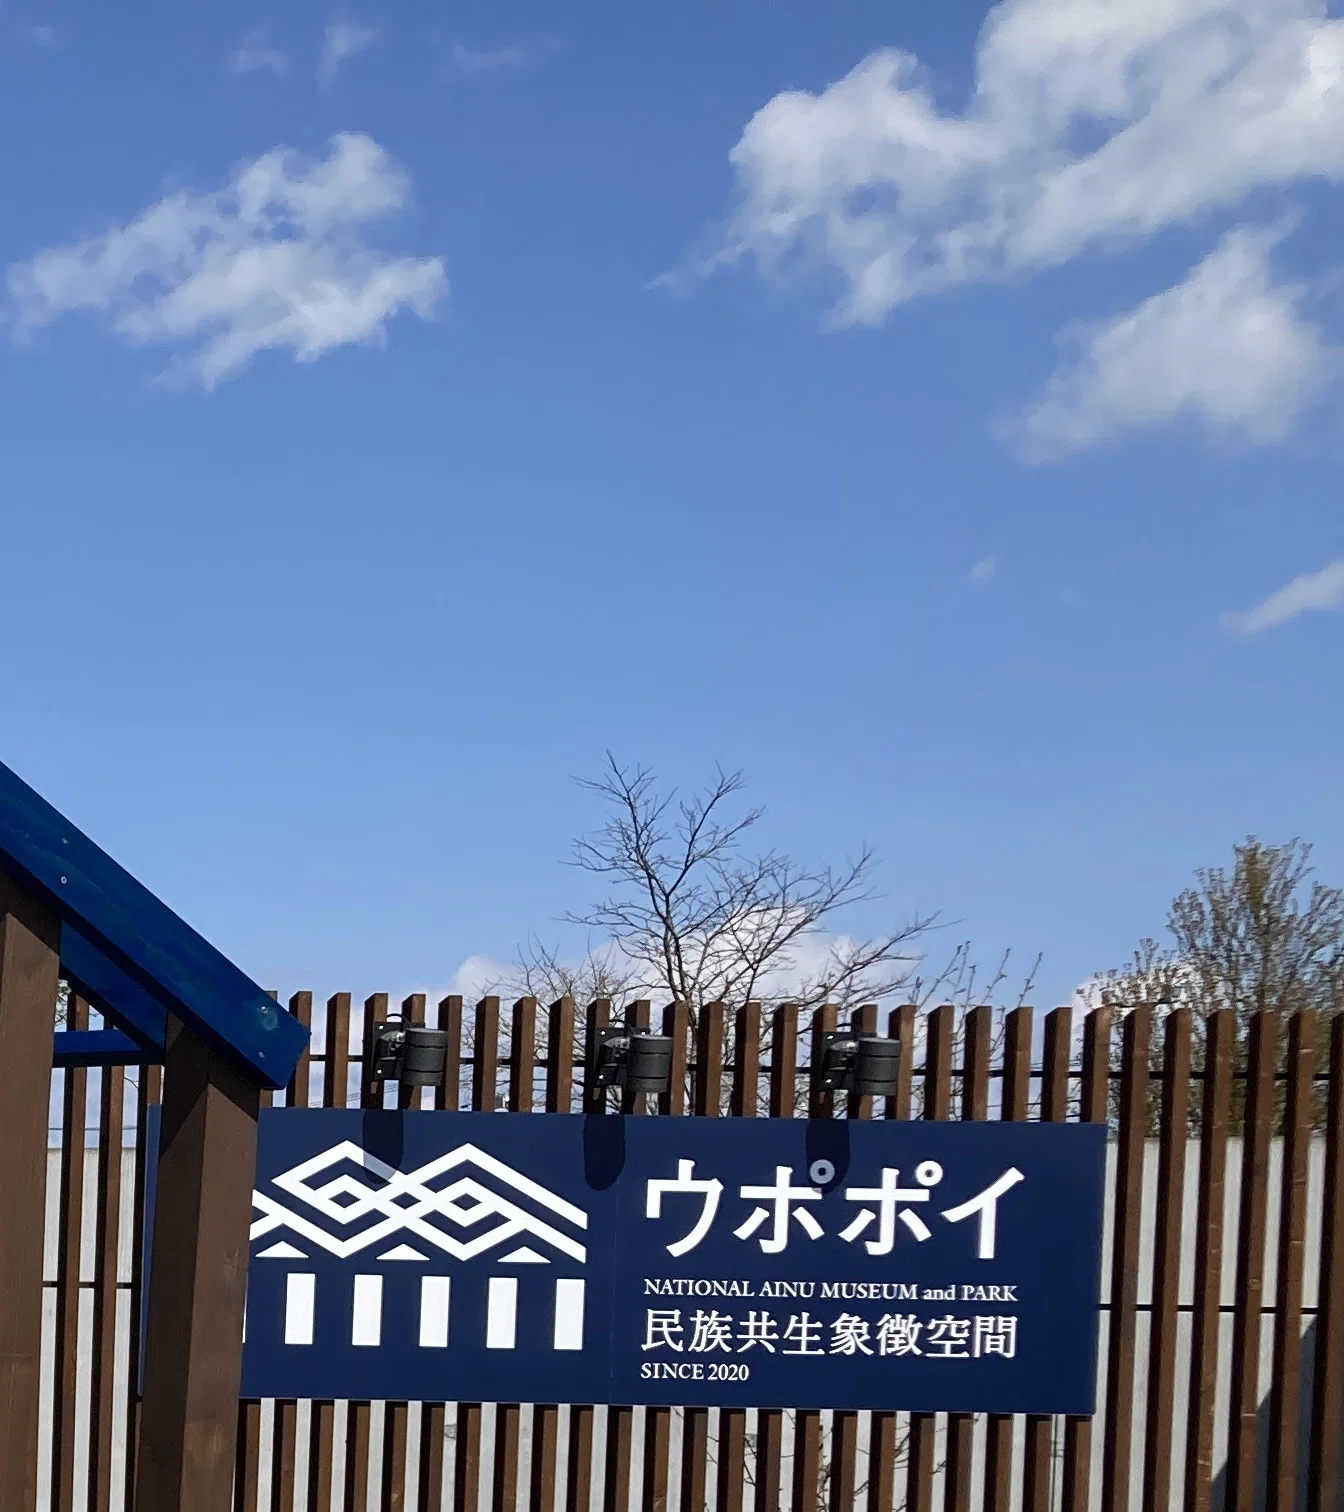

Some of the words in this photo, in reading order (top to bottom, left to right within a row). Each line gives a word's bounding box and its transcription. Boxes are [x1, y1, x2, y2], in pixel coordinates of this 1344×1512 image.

[645, 1158, 1025, 1259] ウポポイ
[643, 1278, 755, 1297] NATIONAL
[758, 1280, 816, 1299] AINU
[819, 1282, 918, 1300] MUSEUM
[922, 1284, 956, 1301] and
[962, 1285, 1020, 1302] PARK
[641, 1307, 1018, 1359] 民族共生象徴空間
[639, 1362, 705, 1380] SINCE
[708, 1363, 750, 1382] 2020
